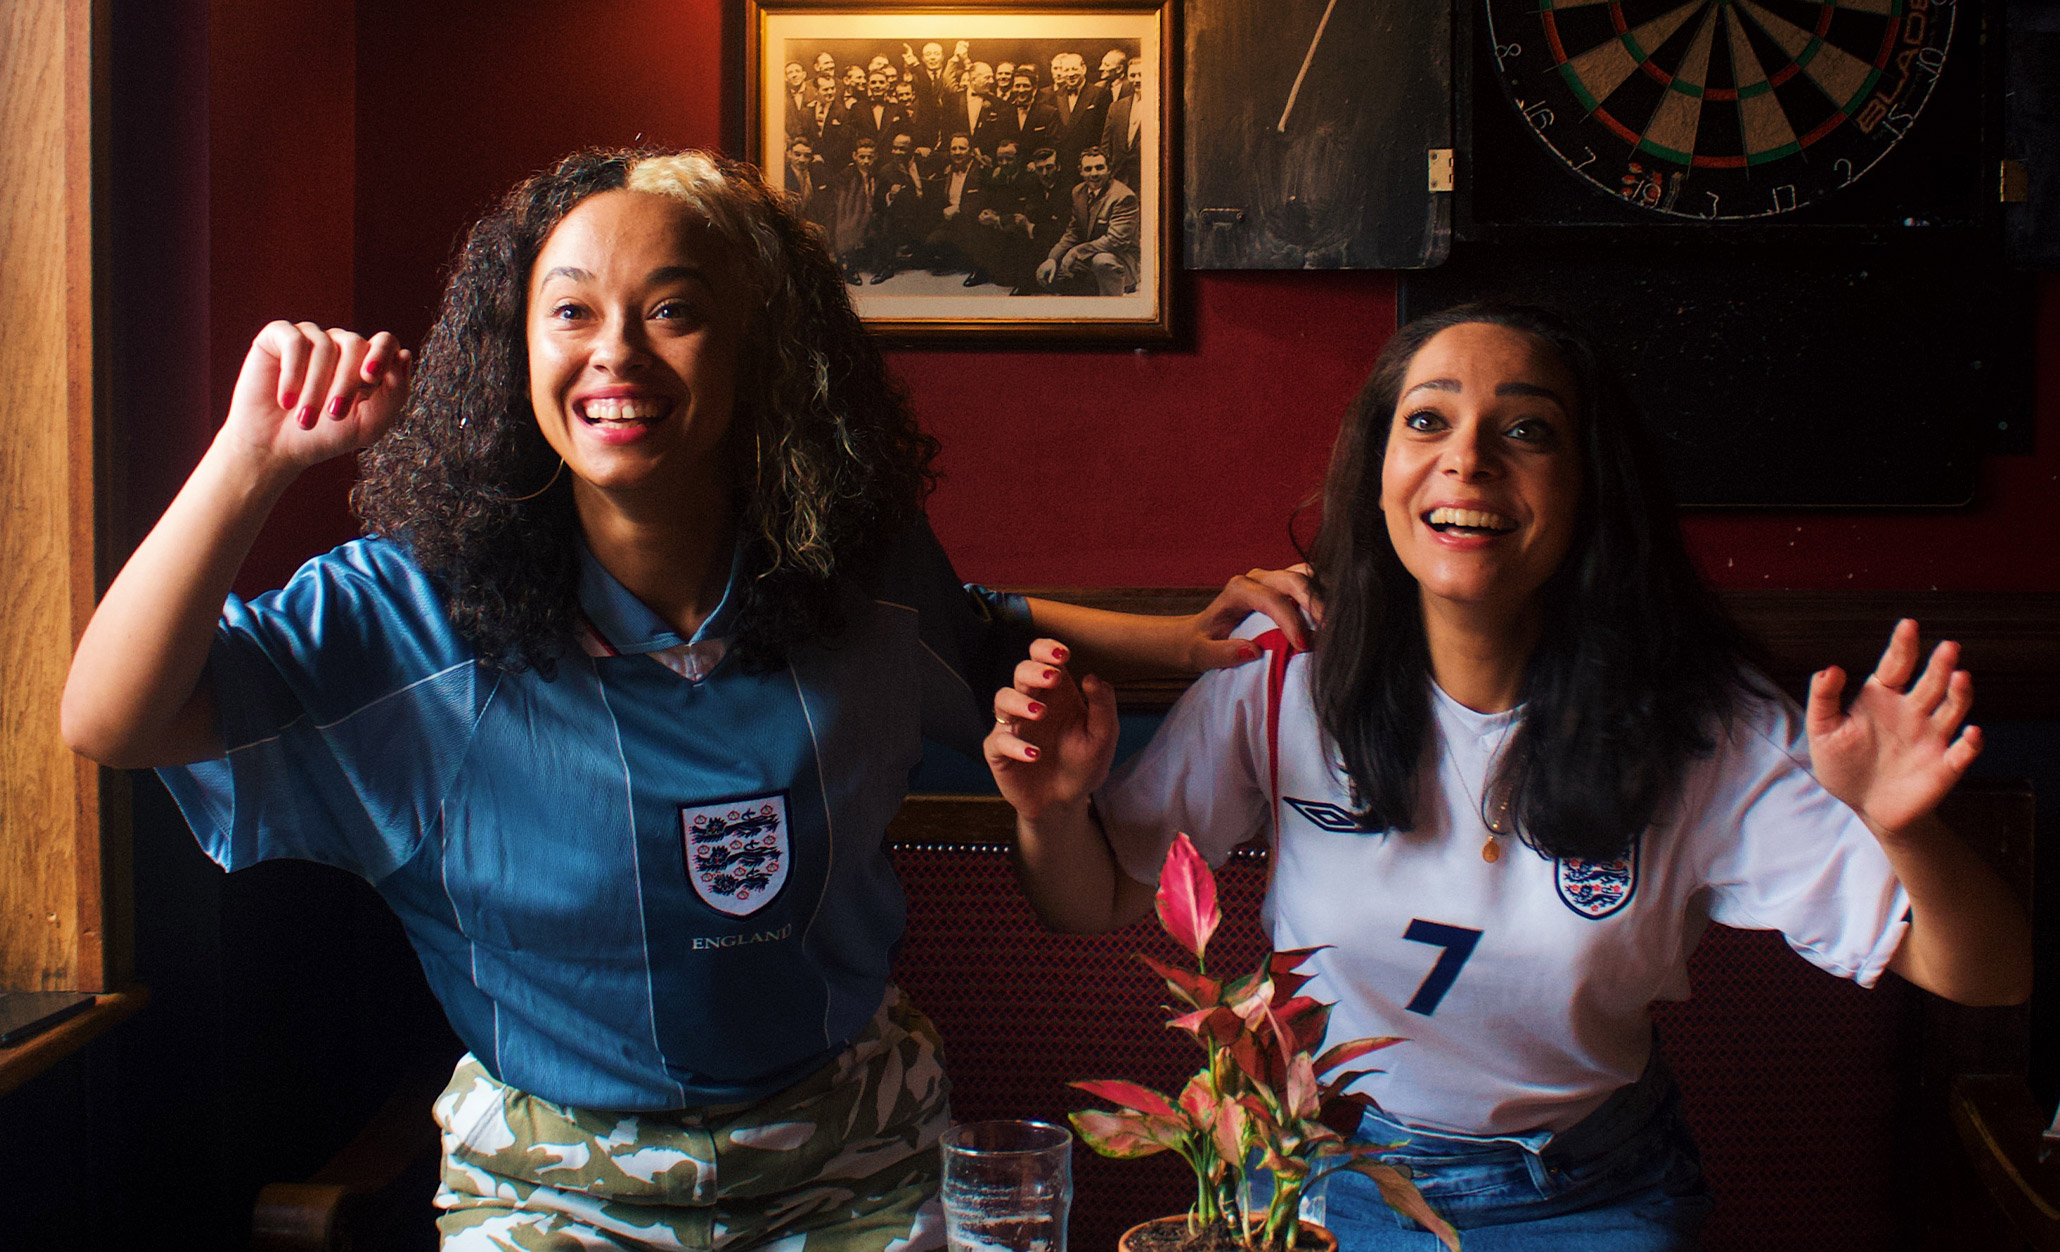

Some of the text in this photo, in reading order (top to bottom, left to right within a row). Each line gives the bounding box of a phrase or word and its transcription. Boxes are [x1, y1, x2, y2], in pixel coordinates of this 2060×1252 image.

[1916, 47, 1947, 83] 10
[1517, 100, 1555, 130] 16
[1882, 103, 1915, 141] 15
[1833, 158, 1852, 190] 2
[691, 923, 792, 951] ENGLAND
[1402, 918, 1484, 1017] 7
